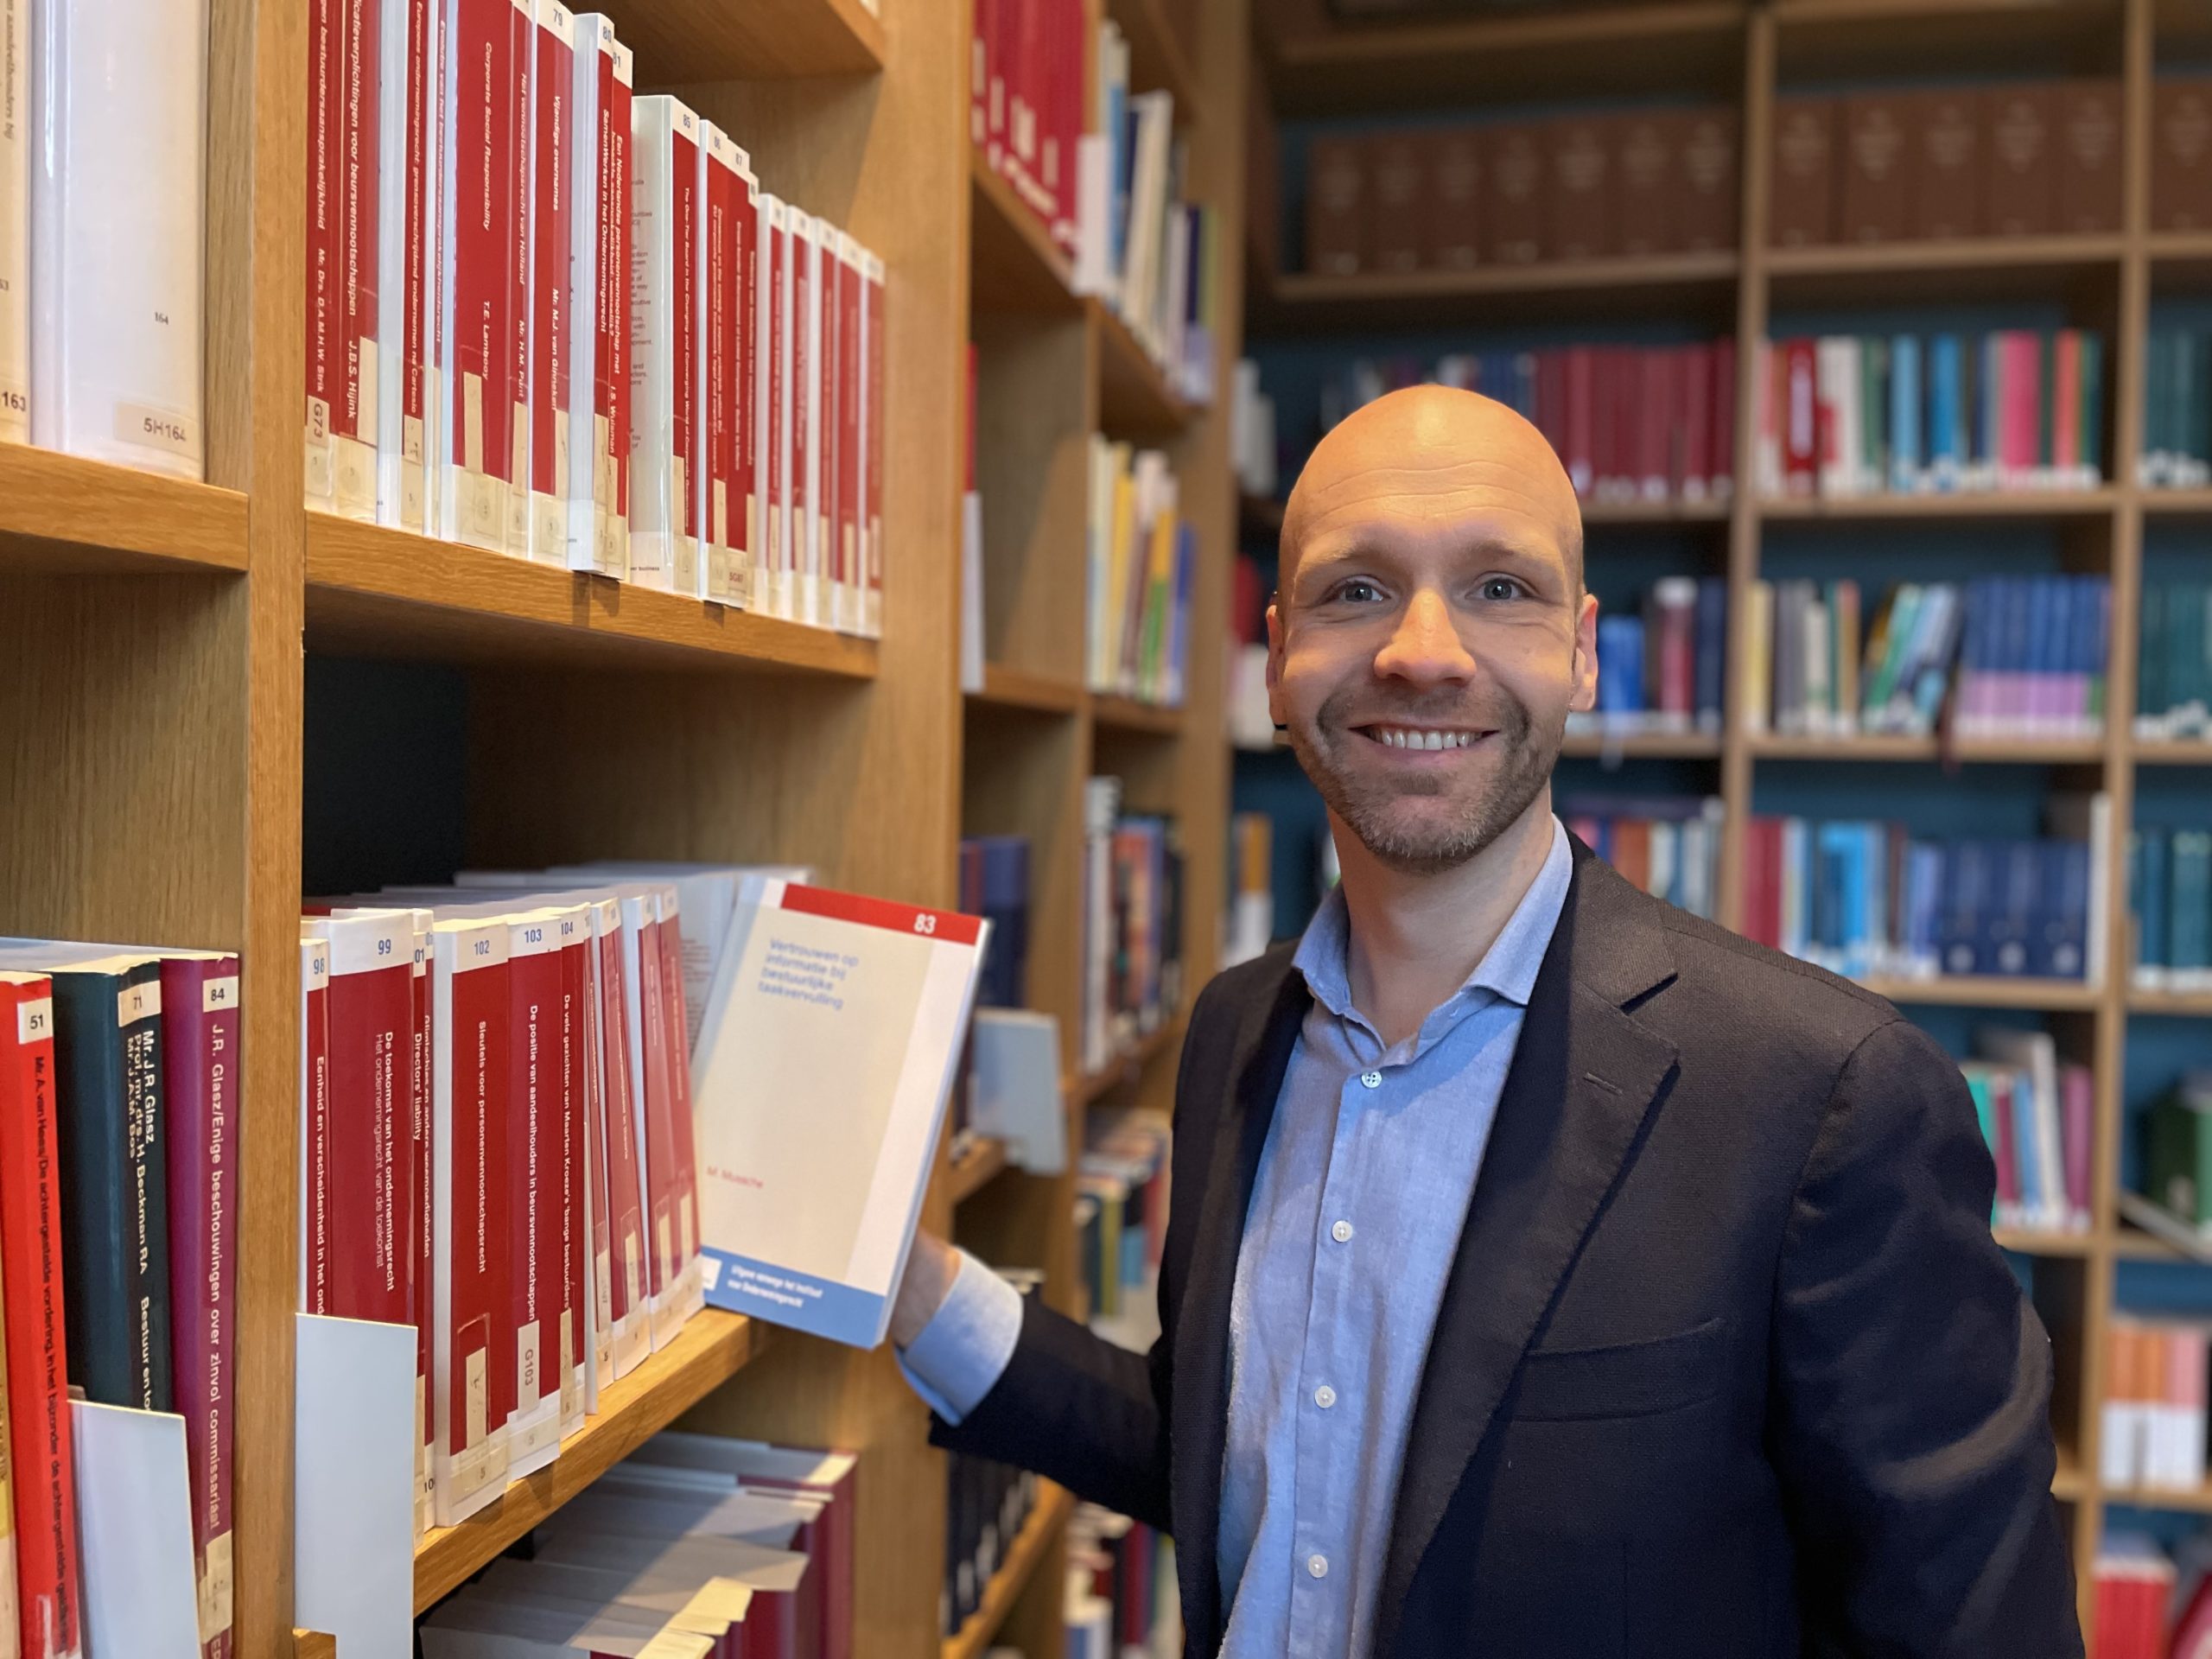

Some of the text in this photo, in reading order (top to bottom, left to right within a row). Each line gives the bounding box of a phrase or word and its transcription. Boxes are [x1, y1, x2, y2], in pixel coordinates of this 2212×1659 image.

[415, 2, 423, 54] Europees
[553, 10, 563, 27] 79
[601, 27, 612, 42] 80
[483, 41, 493, 103] Corporate
[317, 27, 327, 229] bestuurdersaansprakelijkheid
[552, 95, 562, 146] Vijandige
[602, 110, 611, 188] SamenWerken
[482, 146, 492, 232] Responsibility
[603, 190, 609, 200] in
[347, 162, 360, 316] beursvennootschappen
[600, 223, 608, 332] Ondernemingsrecht
[614, 226, 623, 351] personenvennootschap
[155, 312, 168, 325] 164
[551, 308, 560, 333] M.J.
[348, 341, 358, 378] J.B.S.
[411, 352, 416, 365] na
[2, 391, 26, 412] 163
[347, 382, 357, 420] Hijink
[143, 417, 187, 442] 5H164
[314, 403, 324, 439] G73
[524, 928, 543, 944] 103
[562, 922, 574, 936] 104
[914, 913, 937, 934] 83
[378, 938, 392, 956] 99
[474, 940, 490, 956] 102
[766, 952, 827, 974] informatie
[770, 938, 860, 969] Vertrouwen op
[314, 958, 325, 975] 98
[761, 966, 834, 991] bestuurlijke
[133, 995, 143, 1010] 71
[210, 988, 225, 1001] 84
[563, 995, 571, 1010] De
[758, 981, 843, 1010] taakvervulling
[30, 1014, 44, 1029] 51
[529, 1005, 537, 1020] De
[134, 1033, 143, 1076] Prof.
[212, 1025, 225, 1057] J.R.
[375, 1033, 384, 1055] Het
[385, 1032, 393, 1050] De
[528, 1023, 537, 1061] positie
[35, 1057, 45, 1077] Mr.
[385, 1052, 394, 1113] toekomst
[143, 1030, 156, 1144] Mr. J.R. Glasz
[316, 1057, 325, 1111] Eenheid
[412, 1033, 423, 1141] Directors' liability
[37, 1094, 46, 1118] van
[210, 1064, 225, 1164] Glasz/Enige
[373, 1058, 384, 1170] ondernemingsrecht
[135, 1108, 143, 1141] drs.
[317, 1114, 324, 1132] en
[528, 1086, 537, 1176] aandeelhouders
[137, 1143, 145, 1163] H.
[316, 1134, 325, 1244] verscheidenheid
[478, 1099, 487, 1274] personenvennootschapsrecht
[529, 1178, 537, 1188] in
[137, 1165, 147, 1244] Beckman
[375, 1195, 384, 1213] de
[209, 1170, 224, 1302] beschouwingen
[375, 1215, 385, 1268] toekomst
[385, 1166, 395, 1292] ondernemingsrecht
[139, 1246, 149, 1274] RA
[317, 1248, 325, 1262] in
[527, 1190, 537, 1321] beursvennootschappen
[140, 1296, 151, 1389] Bestuur en
[211, 1309, 220, 1344] over
[210, 1351, 222, 1402] zinvol
[524, 1349, 534, 1386] G103
